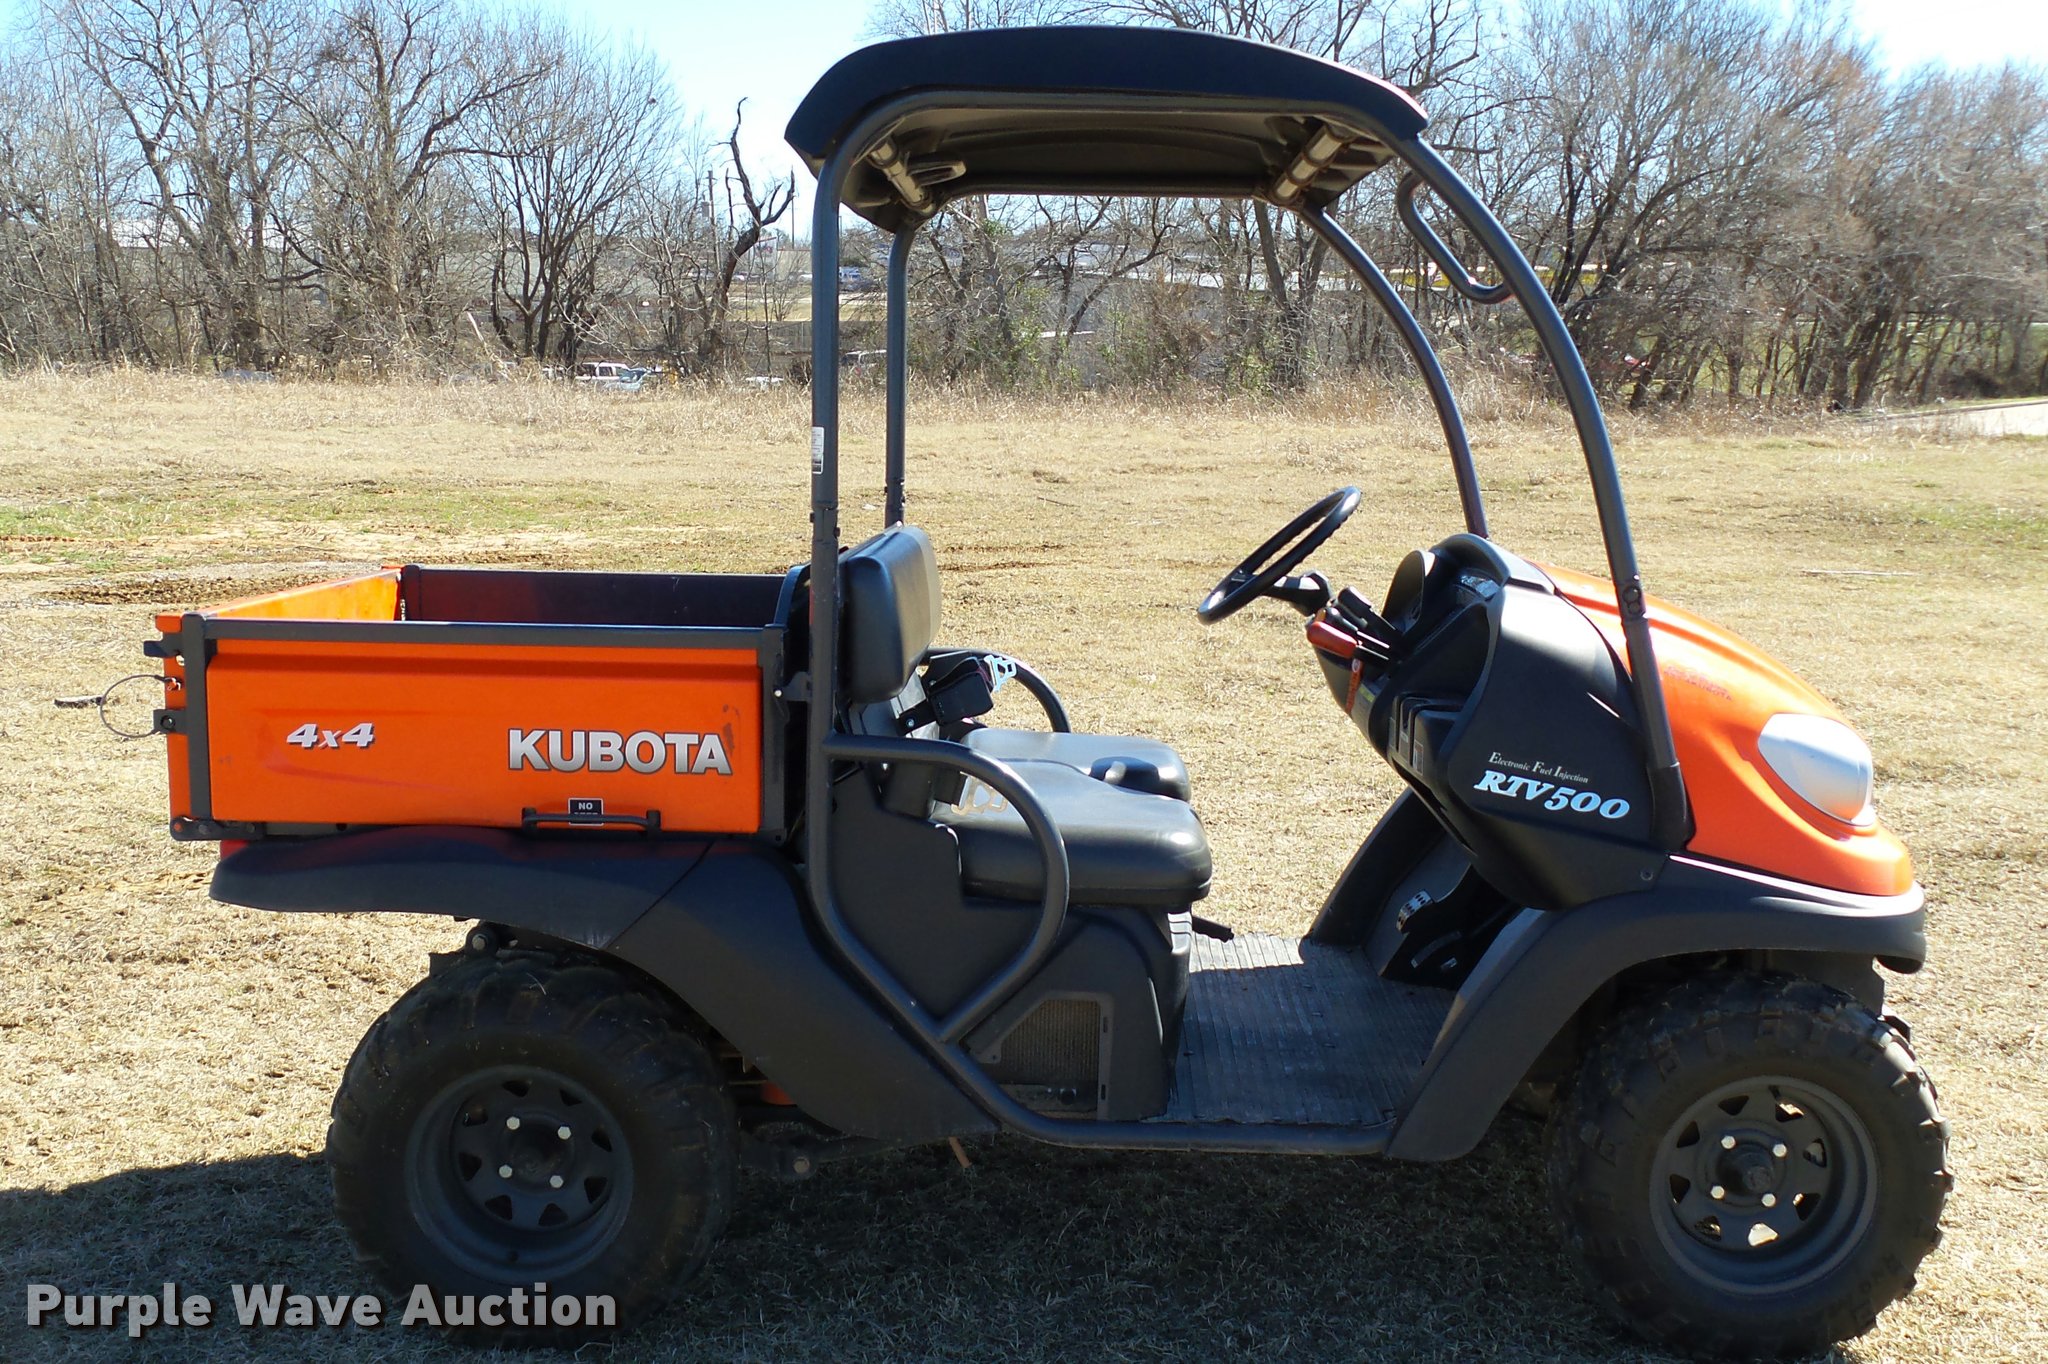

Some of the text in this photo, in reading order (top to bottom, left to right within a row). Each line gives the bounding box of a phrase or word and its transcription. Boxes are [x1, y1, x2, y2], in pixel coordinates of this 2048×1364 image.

[286, 722, 375, 749] 4x4
[508, 728, 733, 776] KUBOTA
[1488, 751, 1589, 784] Electronic Fuel Injection
[578, 801, 594, 811] NO
[1473, 769, 1631, 820] RTV500
